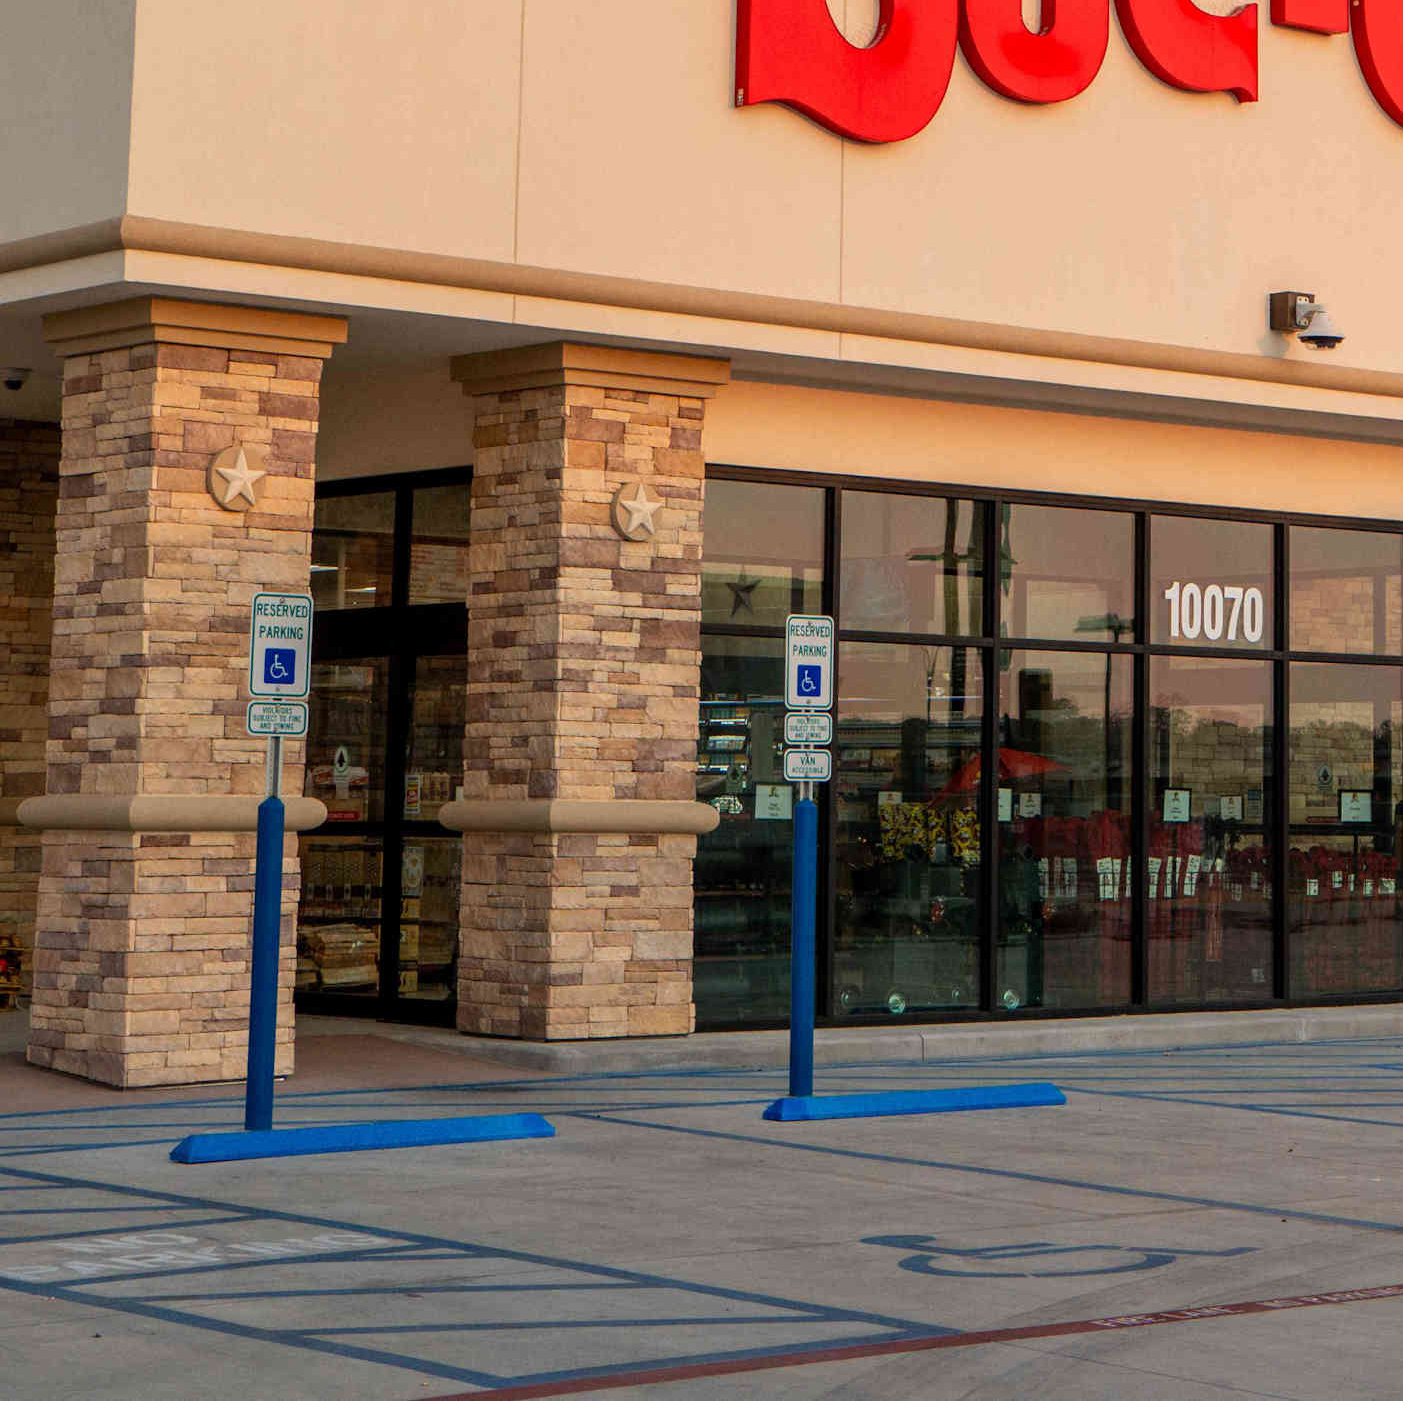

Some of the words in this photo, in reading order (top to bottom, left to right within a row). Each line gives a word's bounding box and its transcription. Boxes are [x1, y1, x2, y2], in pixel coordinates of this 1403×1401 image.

[256, 603, 308, 618] RESERVED
[1165, 581, 1264, 642] 10070
[258, 625, 304, 639] PARKING
[791, 624, 831, 638] RESERVED
[792, 645, 827, 657] PARKING
[800, 756, 816, 766] VAN
[50, 1233, 199, 1253] NO
[0, 1233, 392, 1280] PARKING
